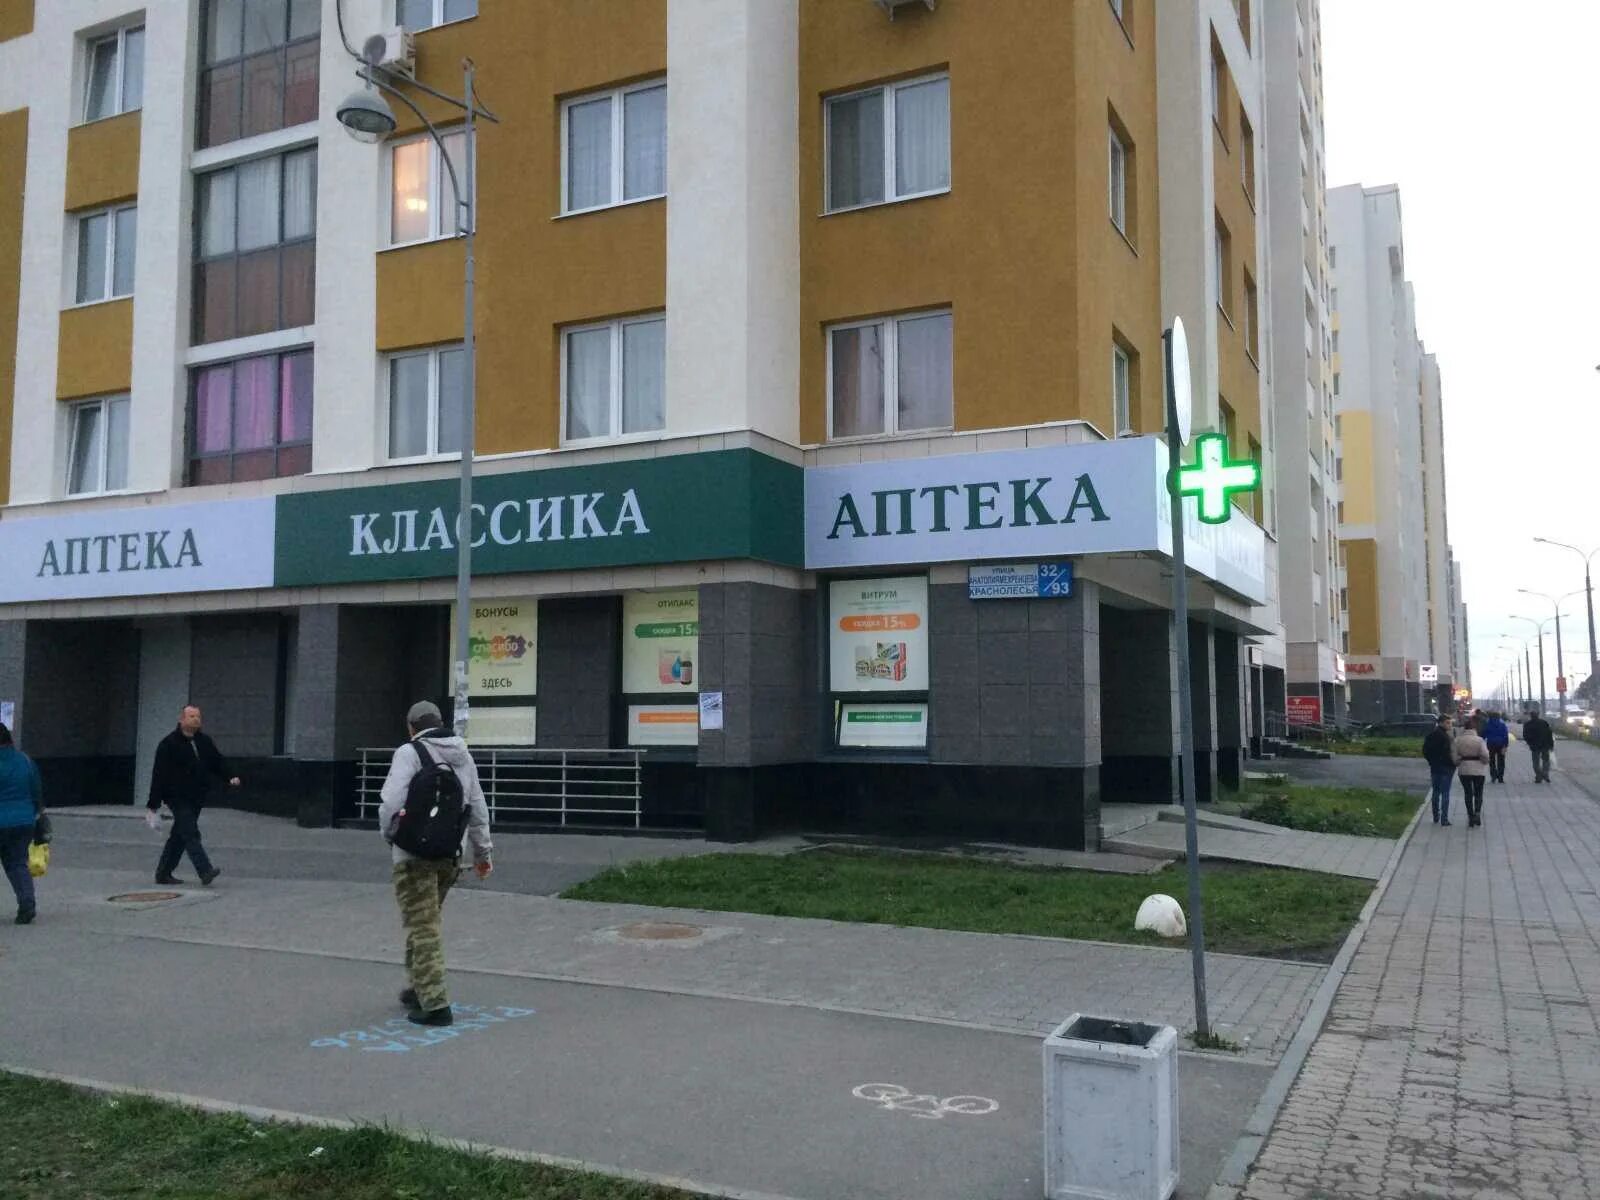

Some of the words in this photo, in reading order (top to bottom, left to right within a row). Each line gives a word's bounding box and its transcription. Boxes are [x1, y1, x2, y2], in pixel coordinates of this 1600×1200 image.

[827, 473, 1111, 539] АПТЕКА
[349, 488, 651, 556] КЛАССИКА
[37, 528, 202, 577] АПТЕКА
[1040, 564, 1058, 576] 32
[1052, 582, 1070, 594] 93
[475, 606, 519, 619] БОНУСЫ
[481, 677, 513, 689] ЗДЕСЬ
